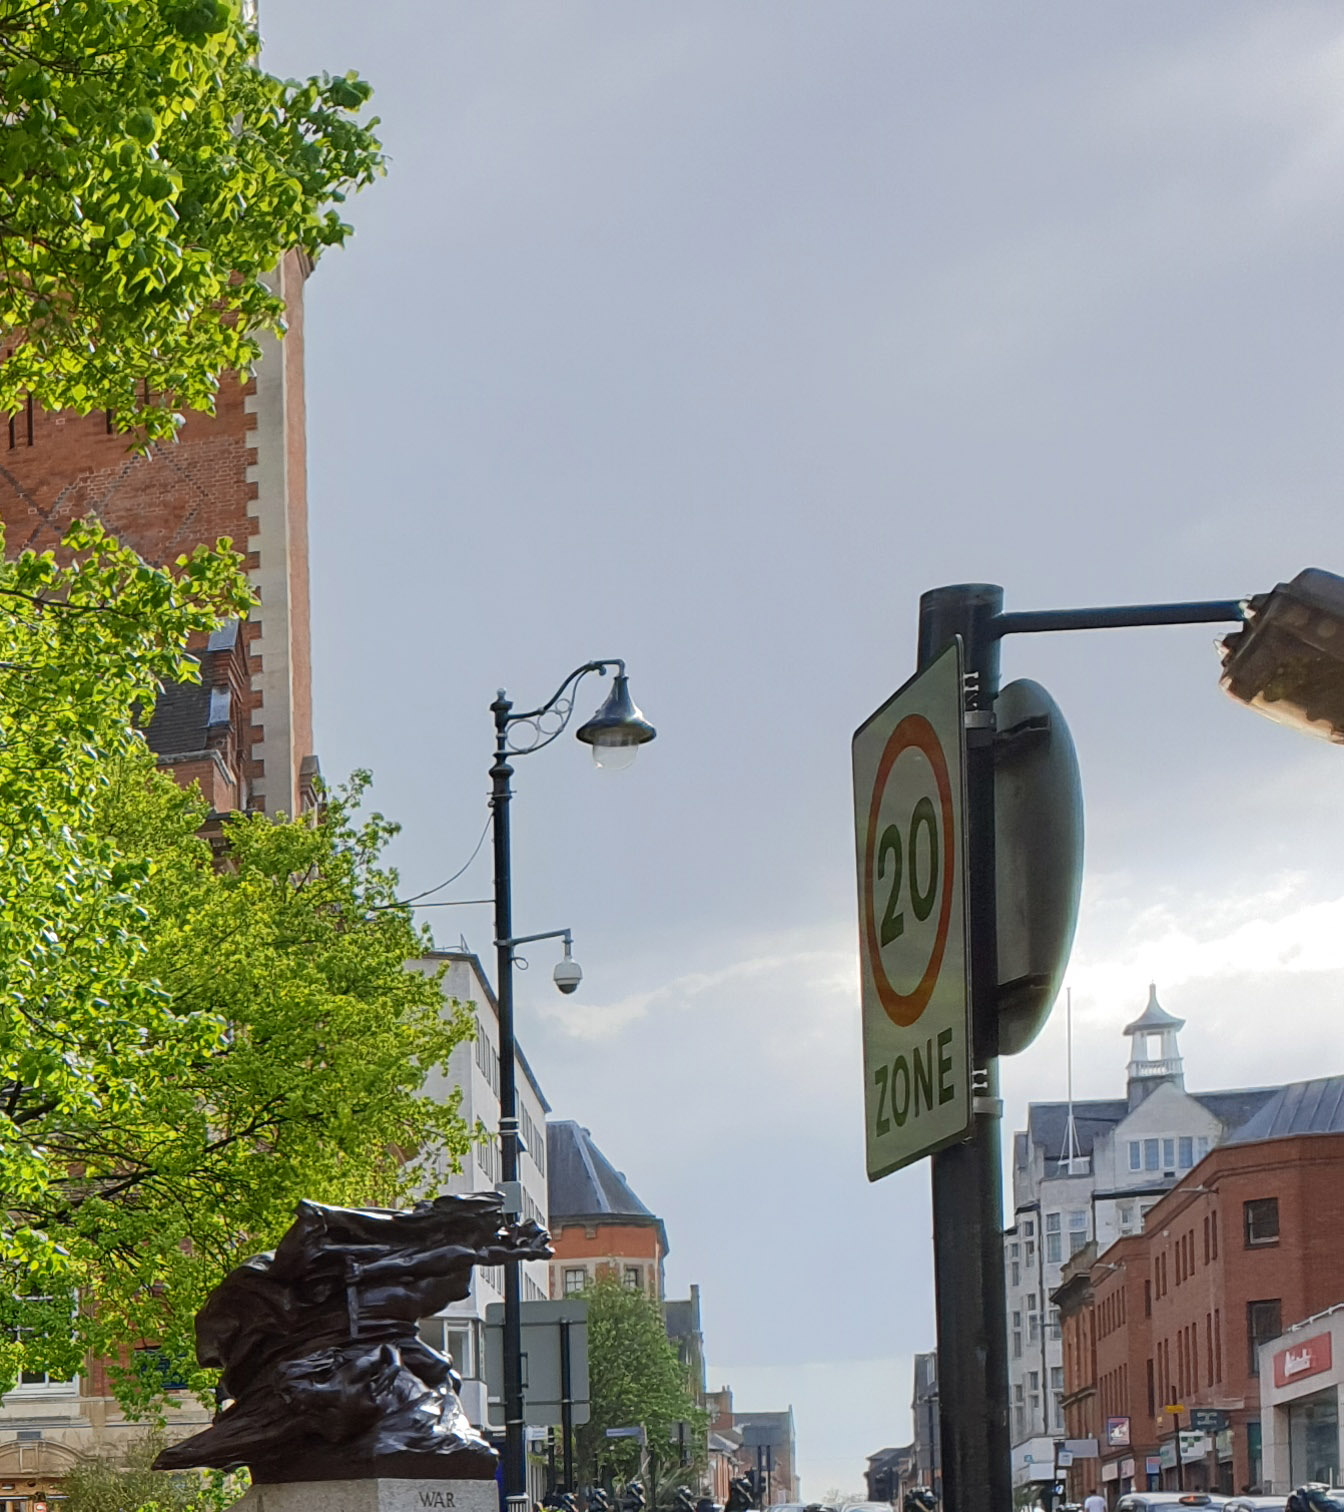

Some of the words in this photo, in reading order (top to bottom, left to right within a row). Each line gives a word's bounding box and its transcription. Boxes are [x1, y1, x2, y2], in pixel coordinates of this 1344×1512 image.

[877, 795, 939, 949] 20
[874, 1027, 955, 1139] ZONE
[418, 1490, 457, 1509] WAR
